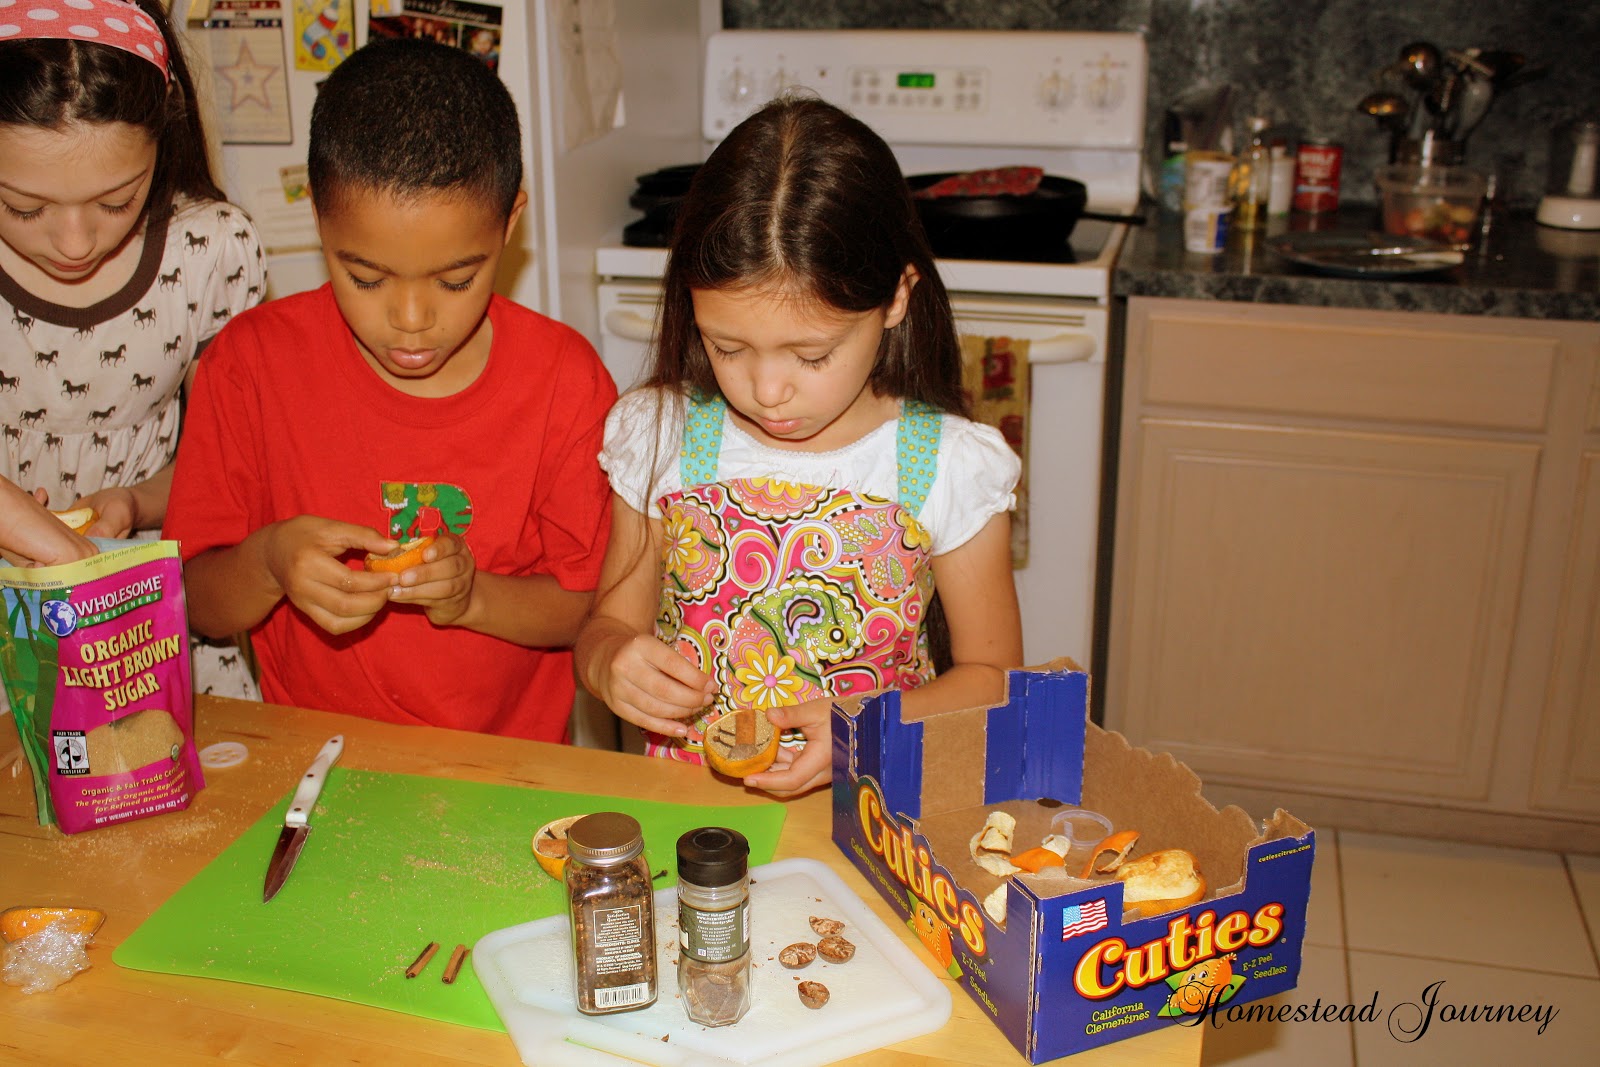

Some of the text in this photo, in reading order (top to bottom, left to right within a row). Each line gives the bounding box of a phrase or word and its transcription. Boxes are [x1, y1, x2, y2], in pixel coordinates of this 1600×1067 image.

[74, 575, 162, 617] WHOLESOME
[84, 594, 159, 626] SWEETENERS
[80, 619, 153, 664] ORGANIC
[61, 634, 180, 689] LIGHT BROWN
[103, 672, 160, 711] SUGAR
[81, 786, 114, 797] Organic
[124, 781, 140, 789] Fair
[141, 774, 163, 786] Trade
[92, 795, 121, 806] Perfect
[123, 789, 155, 800] Organic
[95, 806, 108, 815] for
[110, 798, 141, 810] Refined
[143, 792, 169, 803] Brown
[95, 816, 108, 824] NET
[109, 811, 133, 821] WEIGHT
[1258, 844, 1311, 863] cutiescitrus.com
[858, 784, 987, 957] Cuties
[1072, 902, 1285, 1000] Cuties
[1242, 953, 1273, 972] E-Z Peel
[961, 951, 988, 983] E-Z Peel
[1253, 965, 1288, 980] Seedless
[969, 975, 998, 1017] Seedless
[1085, 1010, 1150, 1035] Clementines
[1092, 1001, 1144, 1022] California
